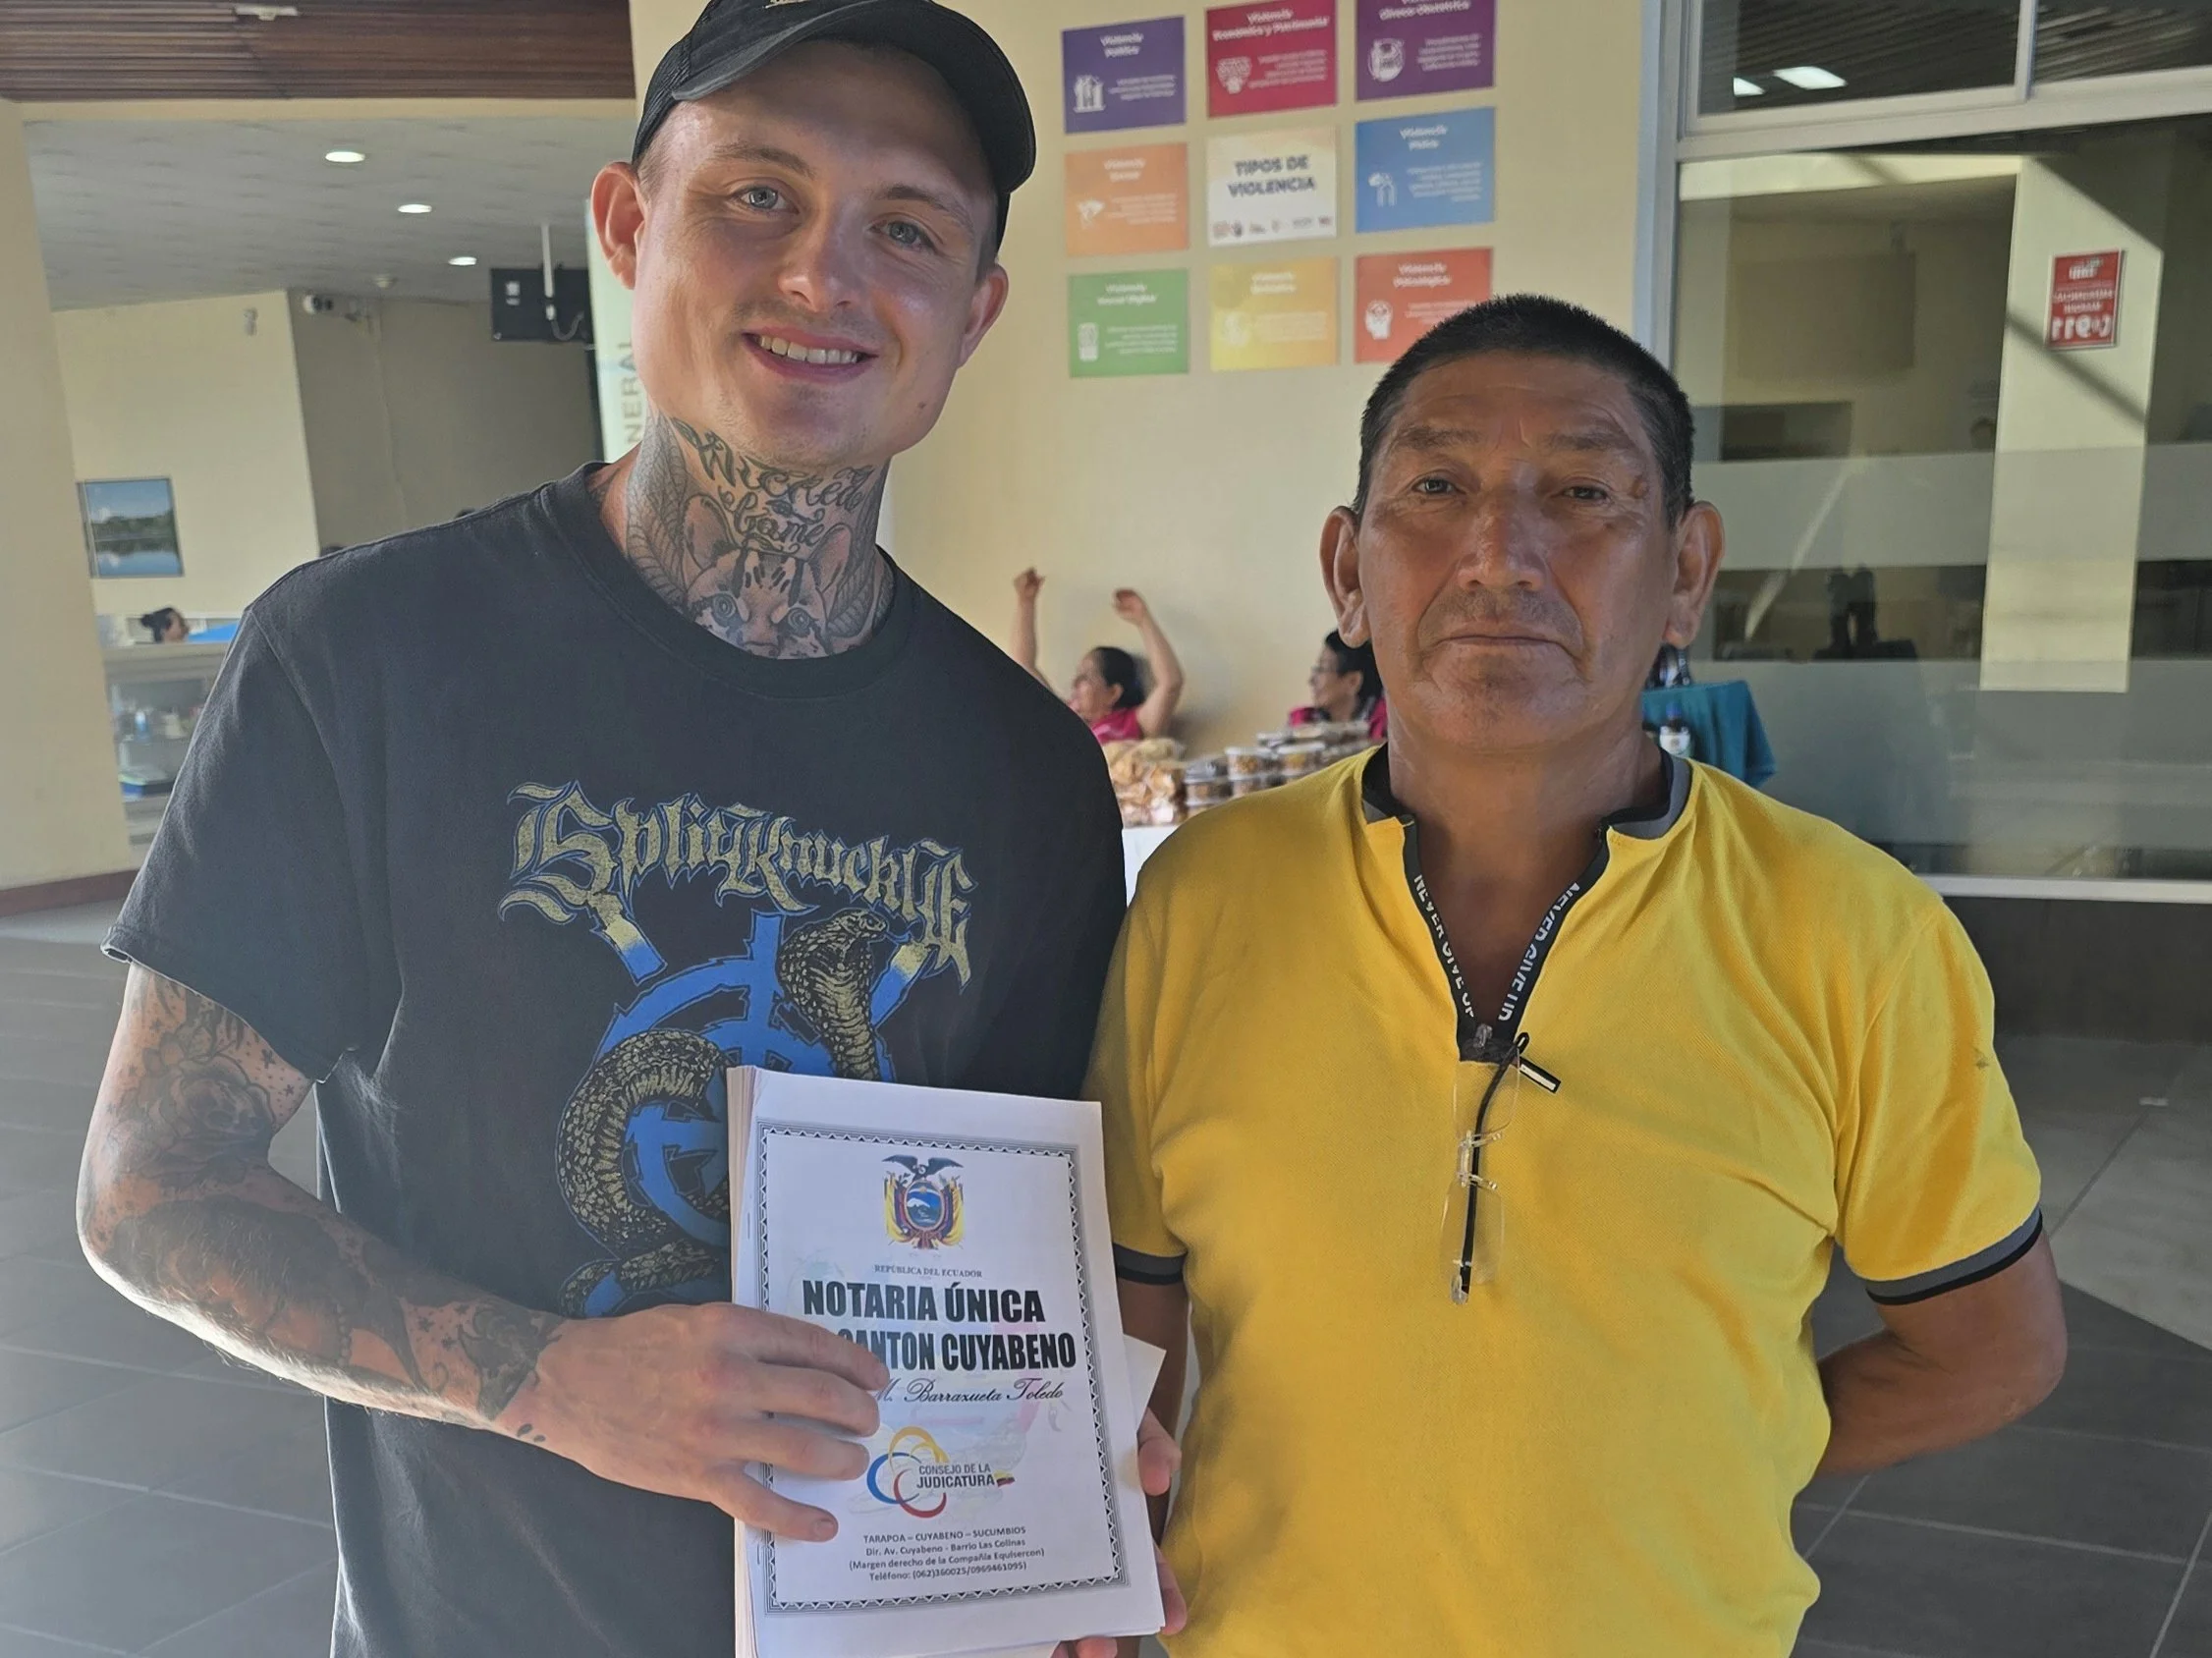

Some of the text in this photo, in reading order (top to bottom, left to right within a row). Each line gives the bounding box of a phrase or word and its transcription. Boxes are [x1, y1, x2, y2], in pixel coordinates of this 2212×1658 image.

[1235, 155, 1309, 176] TIPOS DE
[1227, 177, 1316, 197] VIOLENCIA
[941, 1268, 982, 1278] ECUADOR
[802, 1280, 1046, 1323] NOTARIA ÚNICA
[941, 1332, 1077, 1371] CUYABENO
[1006, 1377, 1065, 1400] Toledo
[918, 1464, 991, 1475] CONSEJO DE LA
[916, 1473, 995, 1489] JUDICATURA
[863, 1534, 906, 1543] TARAPOA
[915, 1531, 964, 1541] CUYABENO
[972, 1526, 1026, 1538] SUCUMBIOS
[900, 1545, 943, 1556] Cuyabeno
[951, 1542, 977, 1551] Barrio
[994, 1539, 1025, 1548] Colinas
[849, 1560, 886, 1571] (Margen
[888, 1558, 923, 1568] derecho
